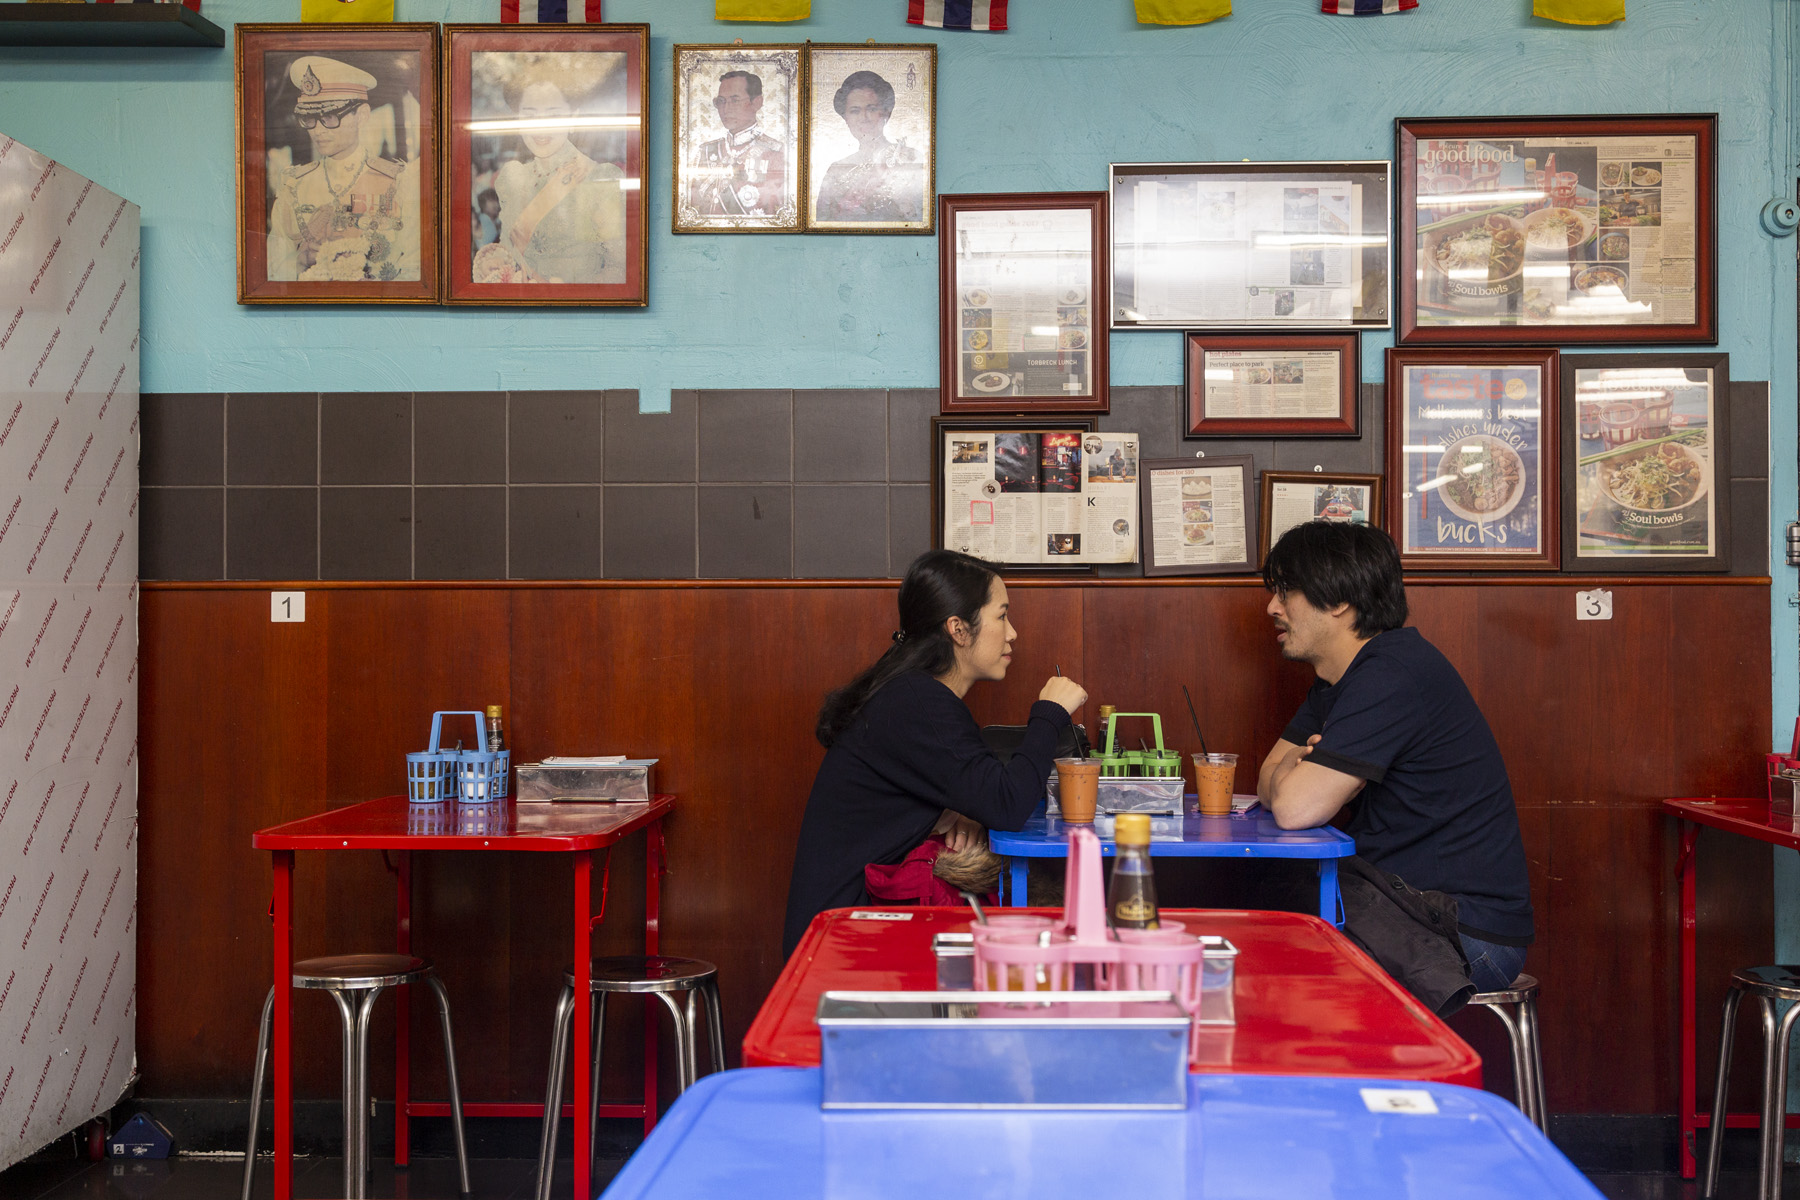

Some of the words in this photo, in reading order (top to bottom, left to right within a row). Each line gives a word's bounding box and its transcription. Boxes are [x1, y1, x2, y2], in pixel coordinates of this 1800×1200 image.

[1454, 283, 1478, 296] Soul
[1479, 284, 1509, 296] bowls
[1252, 360, 1265, 368] park
[1420, 374, 1505, 400] taste
[1438, 422, 1478, 448] dishes
[1483, 421, 1529, 451] under
[1087, 496, 1096, 507] K
[1629, 511, 1653, 525] Soul
[1653, 512, 1684, 525] bowls
[1437, 515, 1508, 544] bucks
[281, 596, 291, 619] 1
[1586, 595, 1602, 617] 3
[115, 1145, 122, 1154] 2
